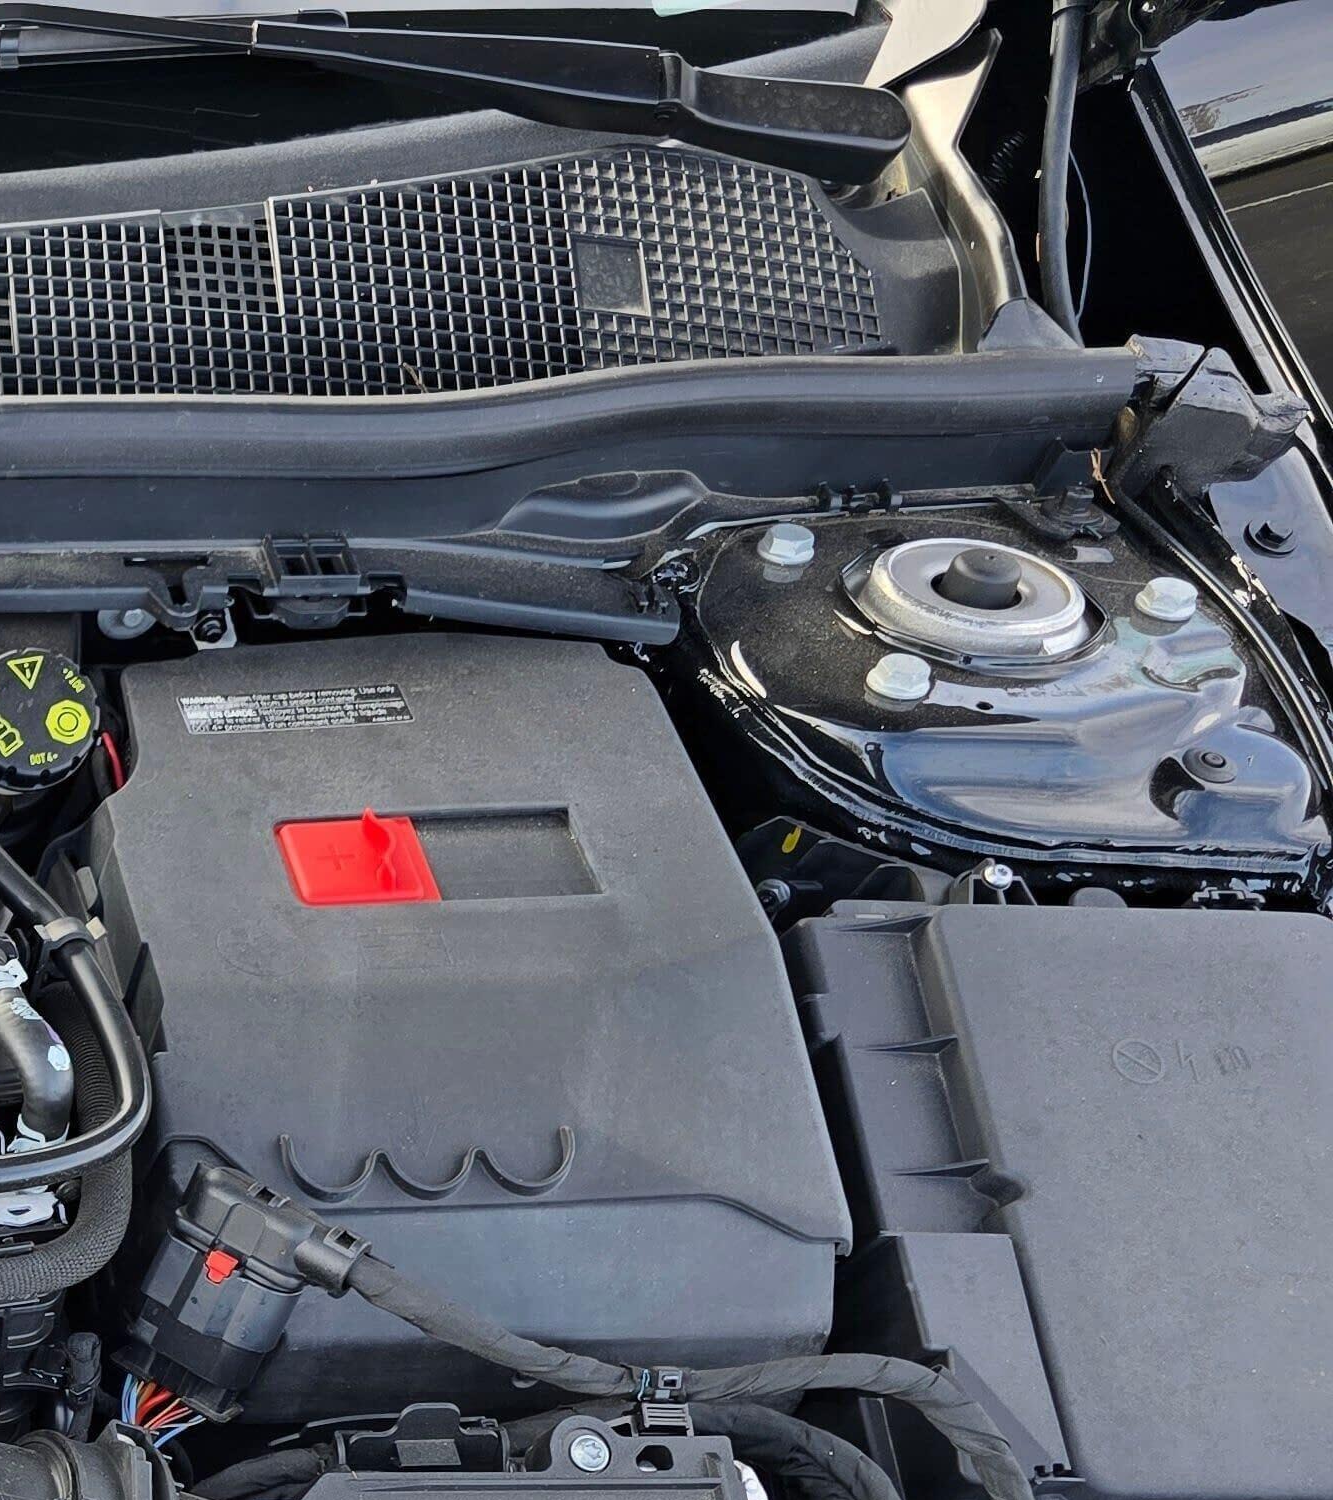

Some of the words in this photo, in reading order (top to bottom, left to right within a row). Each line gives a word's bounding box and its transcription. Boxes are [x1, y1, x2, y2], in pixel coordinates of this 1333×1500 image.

[358, 687, 376, 695] Use
[377, 685, 395, 695] only
[28, 751, 47, 766] DOT
